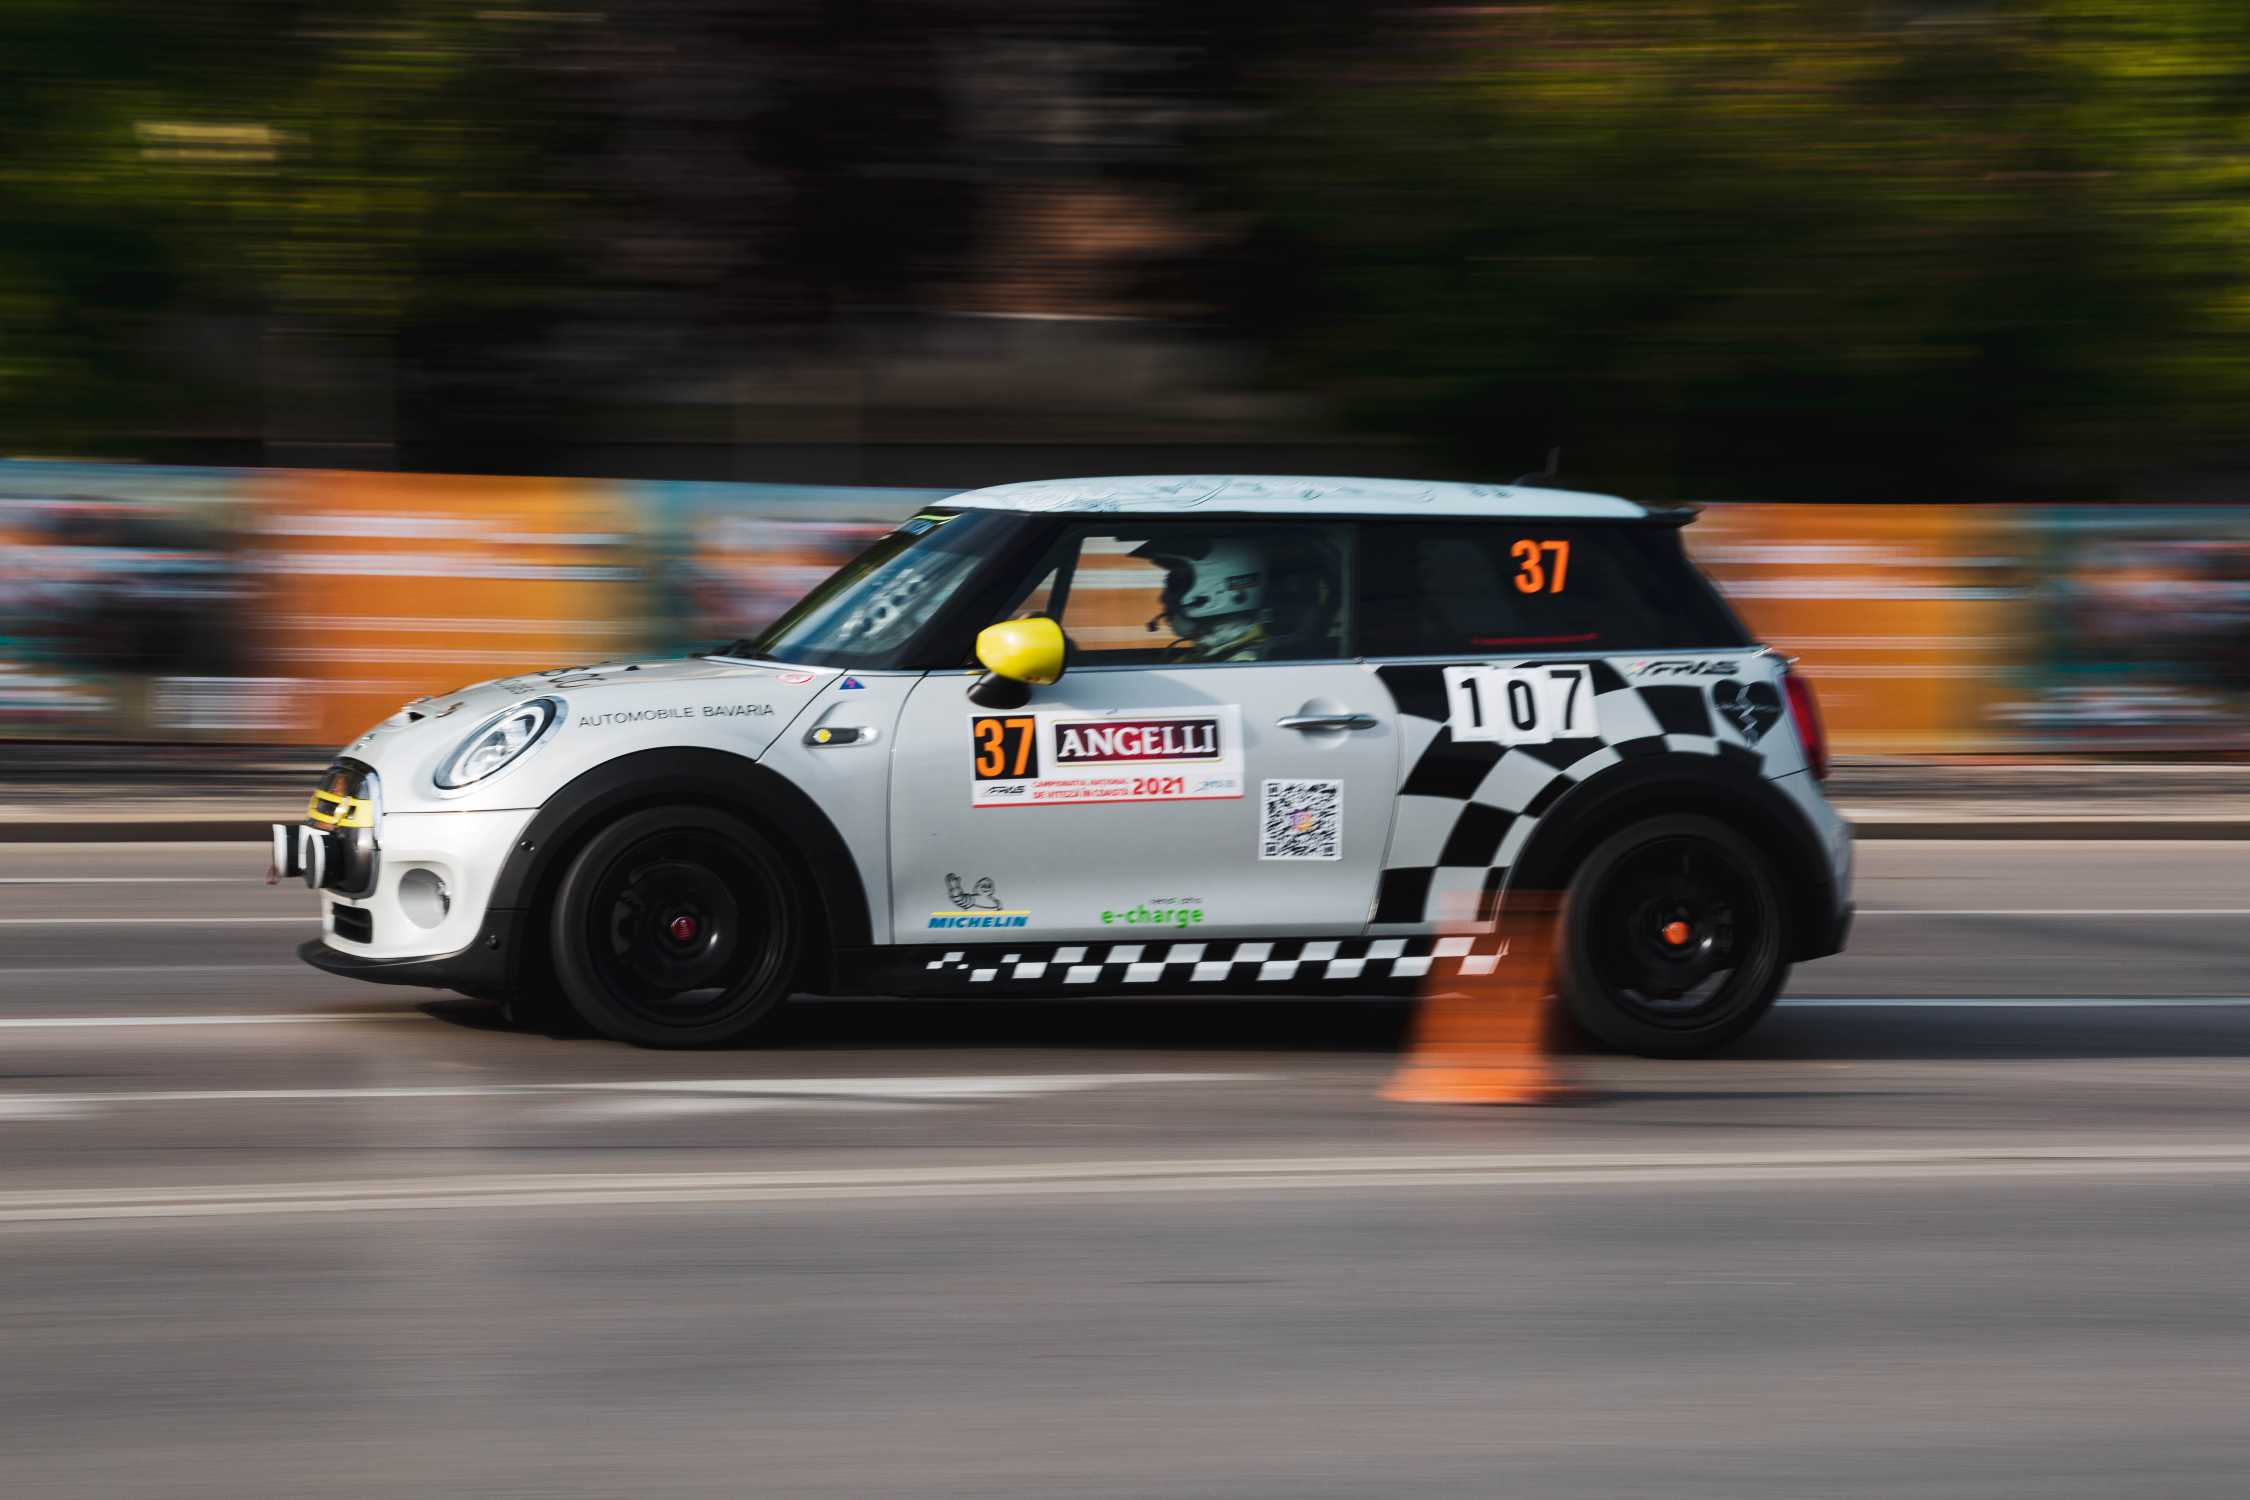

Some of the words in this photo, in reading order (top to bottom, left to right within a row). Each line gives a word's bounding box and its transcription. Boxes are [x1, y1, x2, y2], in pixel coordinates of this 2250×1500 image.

[1510, 538, 1571, 595] 37
[578, 706, 694, 728] AUTOMOBILE
[702, 702, 775, 718] BAVARIA
[1460, 669, 1583, 732] 107
[974, 717, 1036, 777] 37
[1056, 724, 1218, 759] ANGELLI
[1132, 776, 1185, 796] 2021
[927, 916, 1030, 929] MICHELIN
[1102, 904, 1204, 929] e-charge
